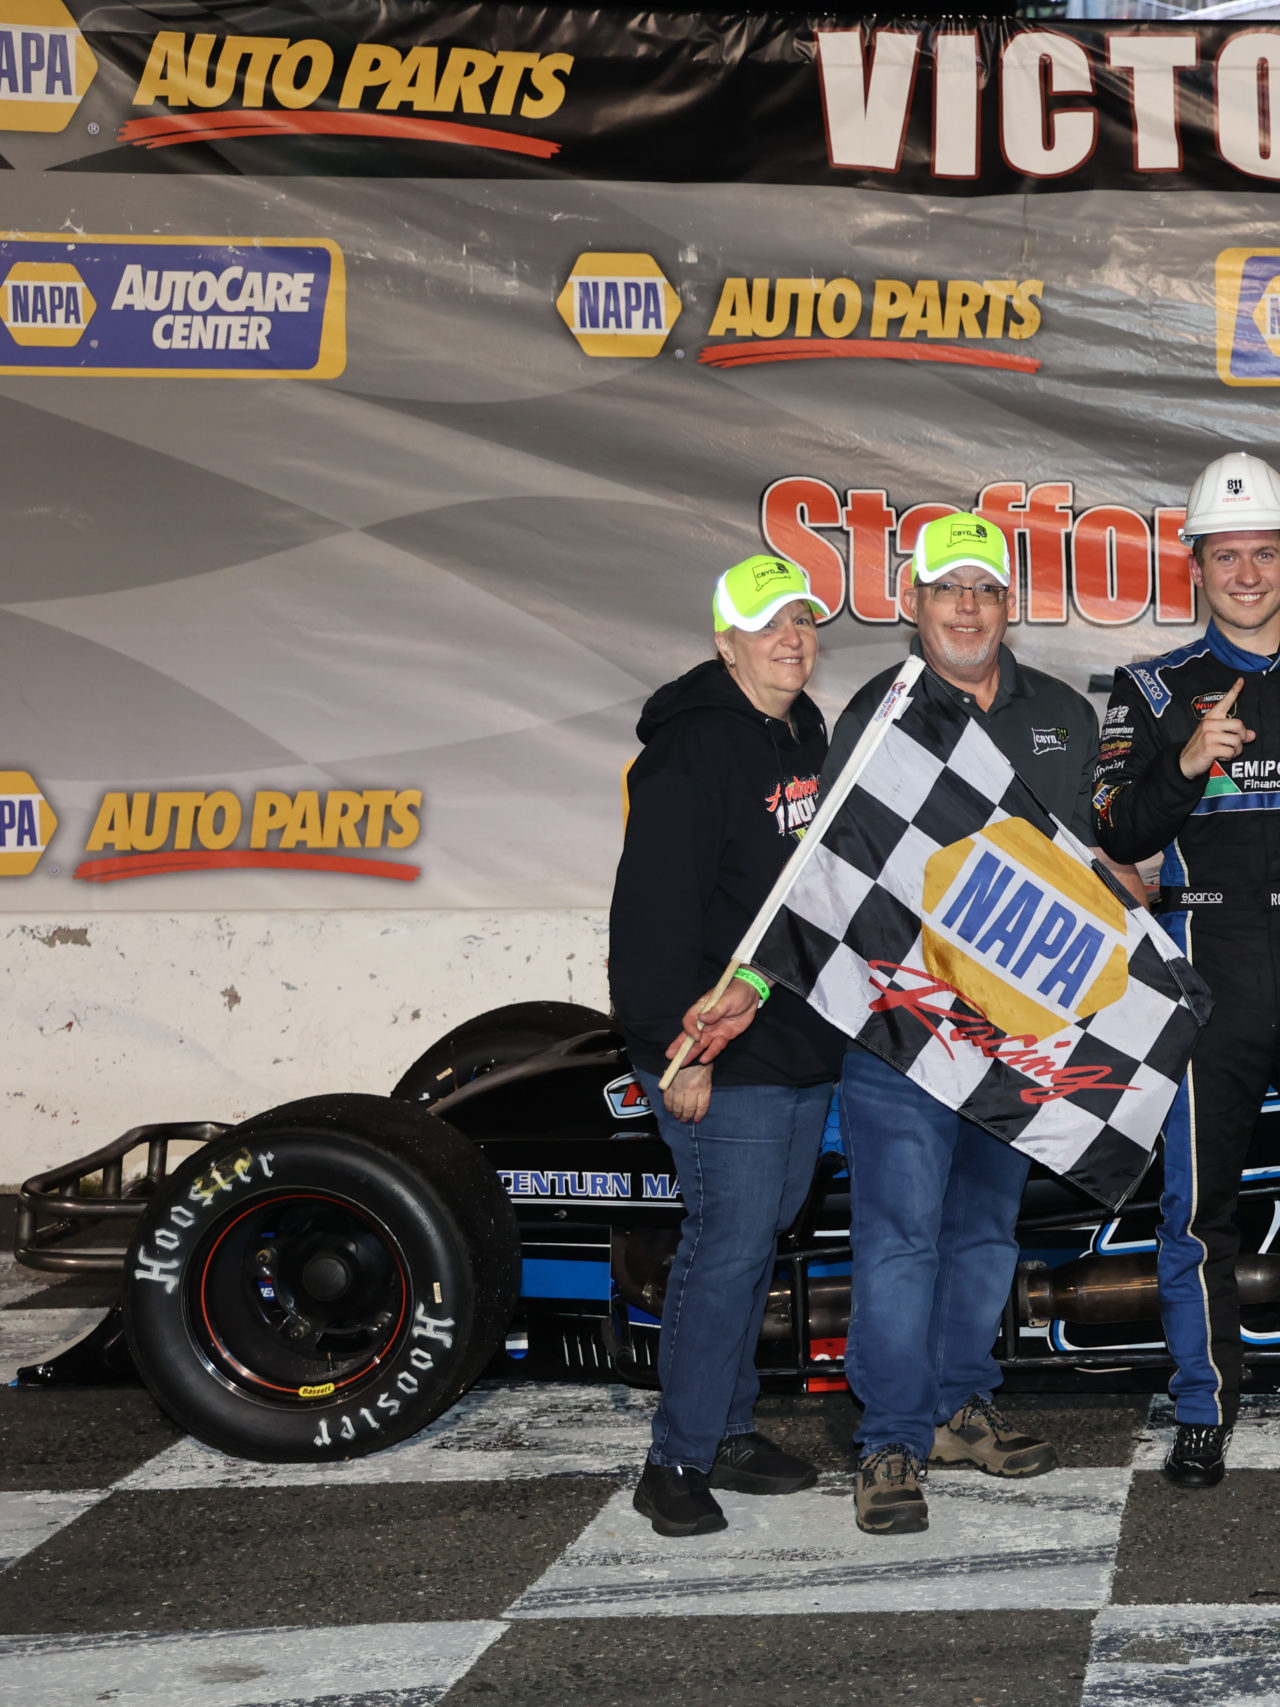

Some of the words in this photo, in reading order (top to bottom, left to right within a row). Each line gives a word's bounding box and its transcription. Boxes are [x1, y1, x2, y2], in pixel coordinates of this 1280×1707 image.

[0, 31, 72, 95] APA
[133, 31, 334, 108] AUTO
[339, 43, 574, 119] PARTS
[12, 284, 82, 325] NAPA
[152, 315, 271, 351] CENTER
[578, 281, 661, 330] NAPA
[708, 277, 862, 338] AUTO
[870, 279, 1043, 341] PARTS
[1227, 479, 1243, 490] 811
[1035, 735, 1057, 744] CBYD
[0, 799, 38, 847] PA
[86, 790, 243, 852] AUTO
[249, 789, 423, 850] PARTS
[941, 850, 1106, 1009] NAPA
[1180, 892, 1224, 904] sparco
[868, 959, 1142, 1105] Racing
[313, 1302, 455, 1447] Hoosier
